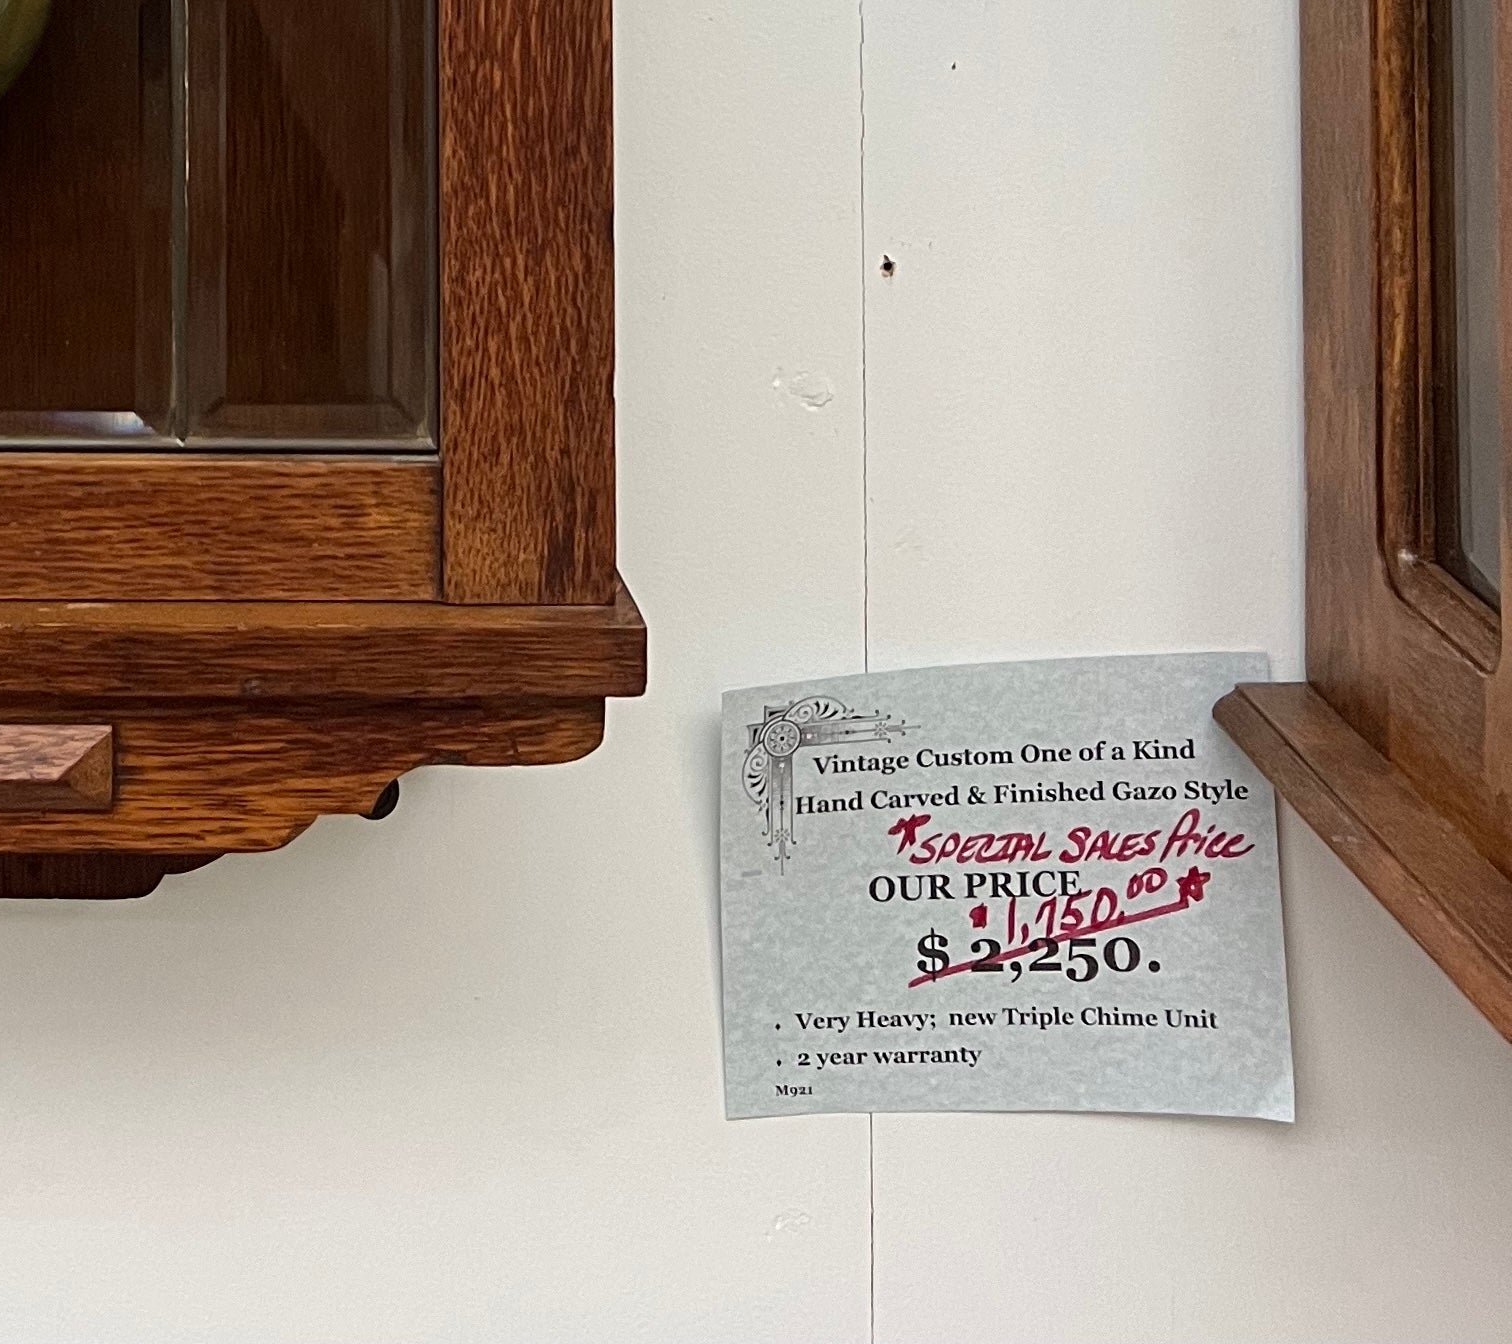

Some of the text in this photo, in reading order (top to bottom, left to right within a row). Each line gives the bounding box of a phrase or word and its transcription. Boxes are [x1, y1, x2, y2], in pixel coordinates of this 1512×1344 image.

[813, 739, 1195, 775] Vintage Custom One of a Kind
[795, 779, 1249, 815] Hand Carved & Finished Gazo Style
[909, 832, 1052, 865] SPECIAL
[1058, 826, 1162, 863] SALES
[868, 871, 1082, 902] OUR PRICE
[795, 1006, 1219, 1033] Very Heavy; new Triple Chime Unit
[797, 1046, 982, 1070] 2 year warranty
[775, 1085, 813, 1097] M921
